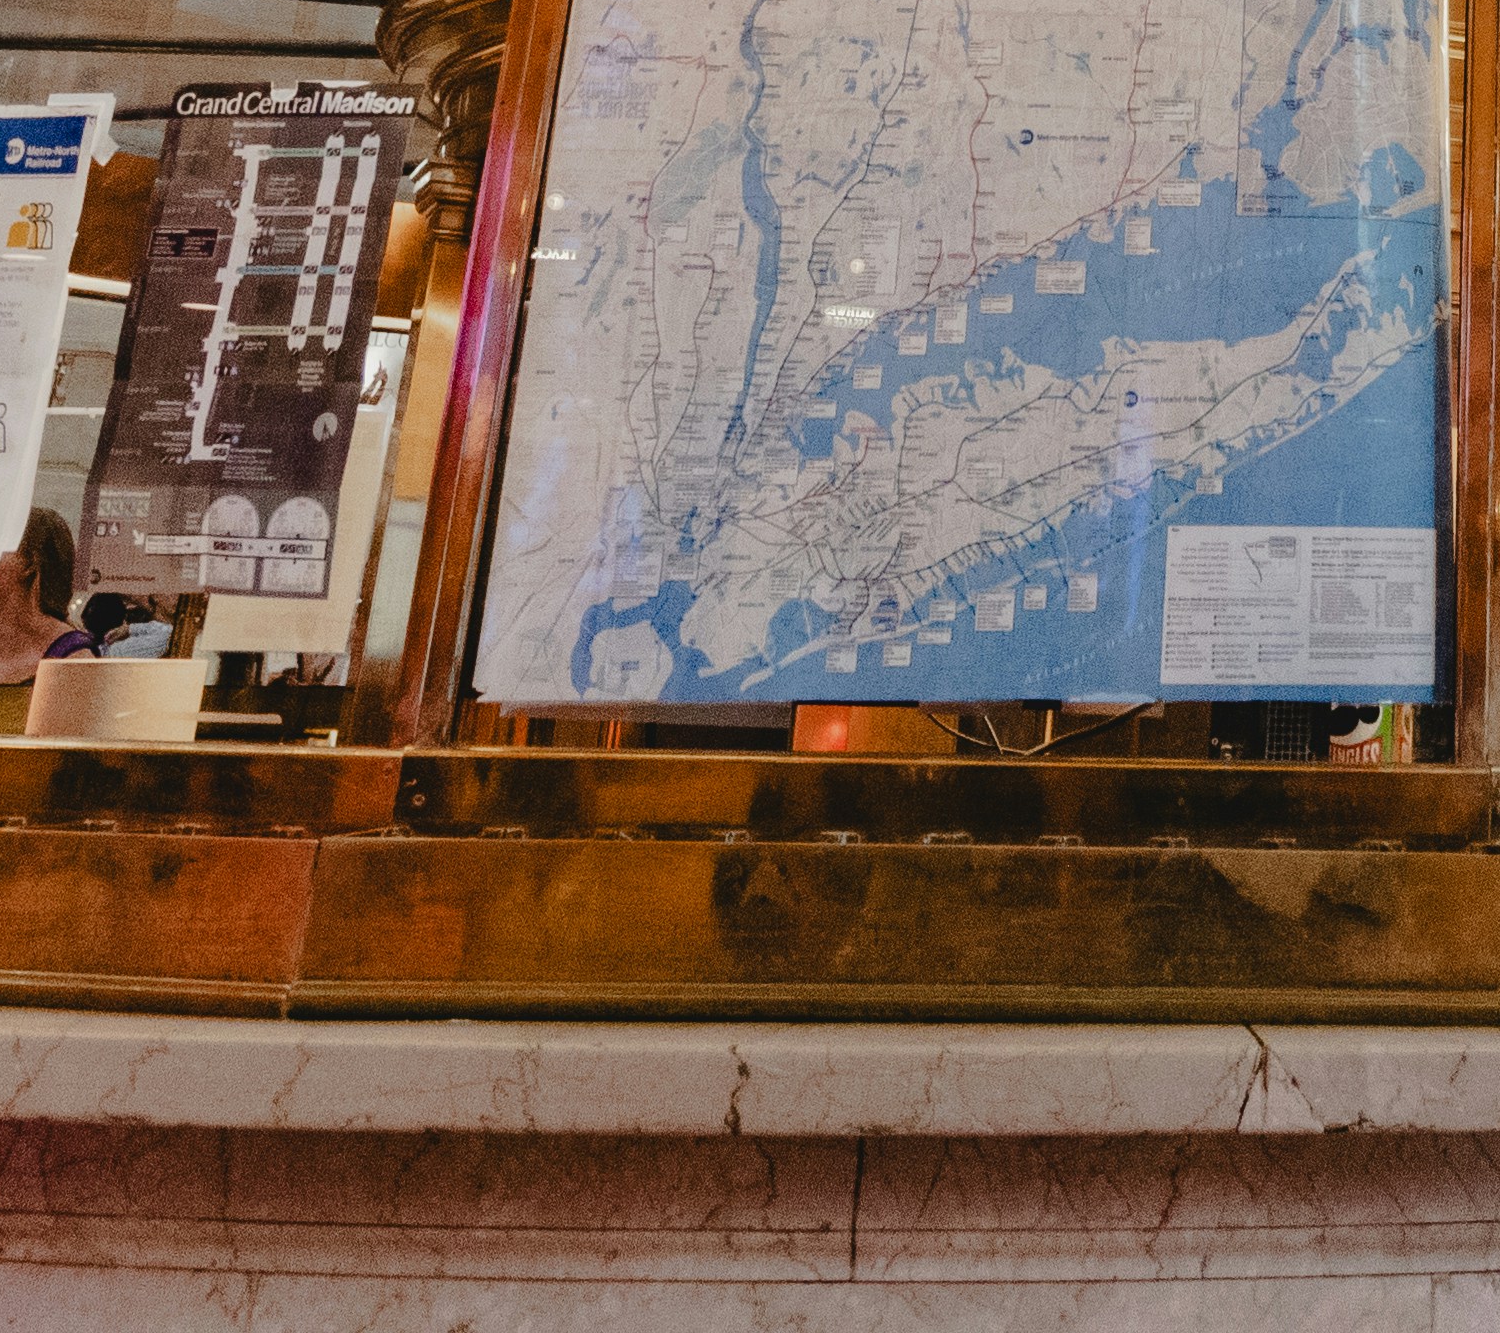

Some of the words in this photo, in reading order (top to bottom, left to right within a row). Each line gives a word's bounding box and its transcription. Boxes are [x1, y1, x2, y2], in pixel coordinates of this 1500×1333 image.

[176, 92, 243, 116] Grand
[320, 90, 415, 115] Madison
[26, 144, 81, 158] Metro-North
[24, 156, 62, 169] Railroad
